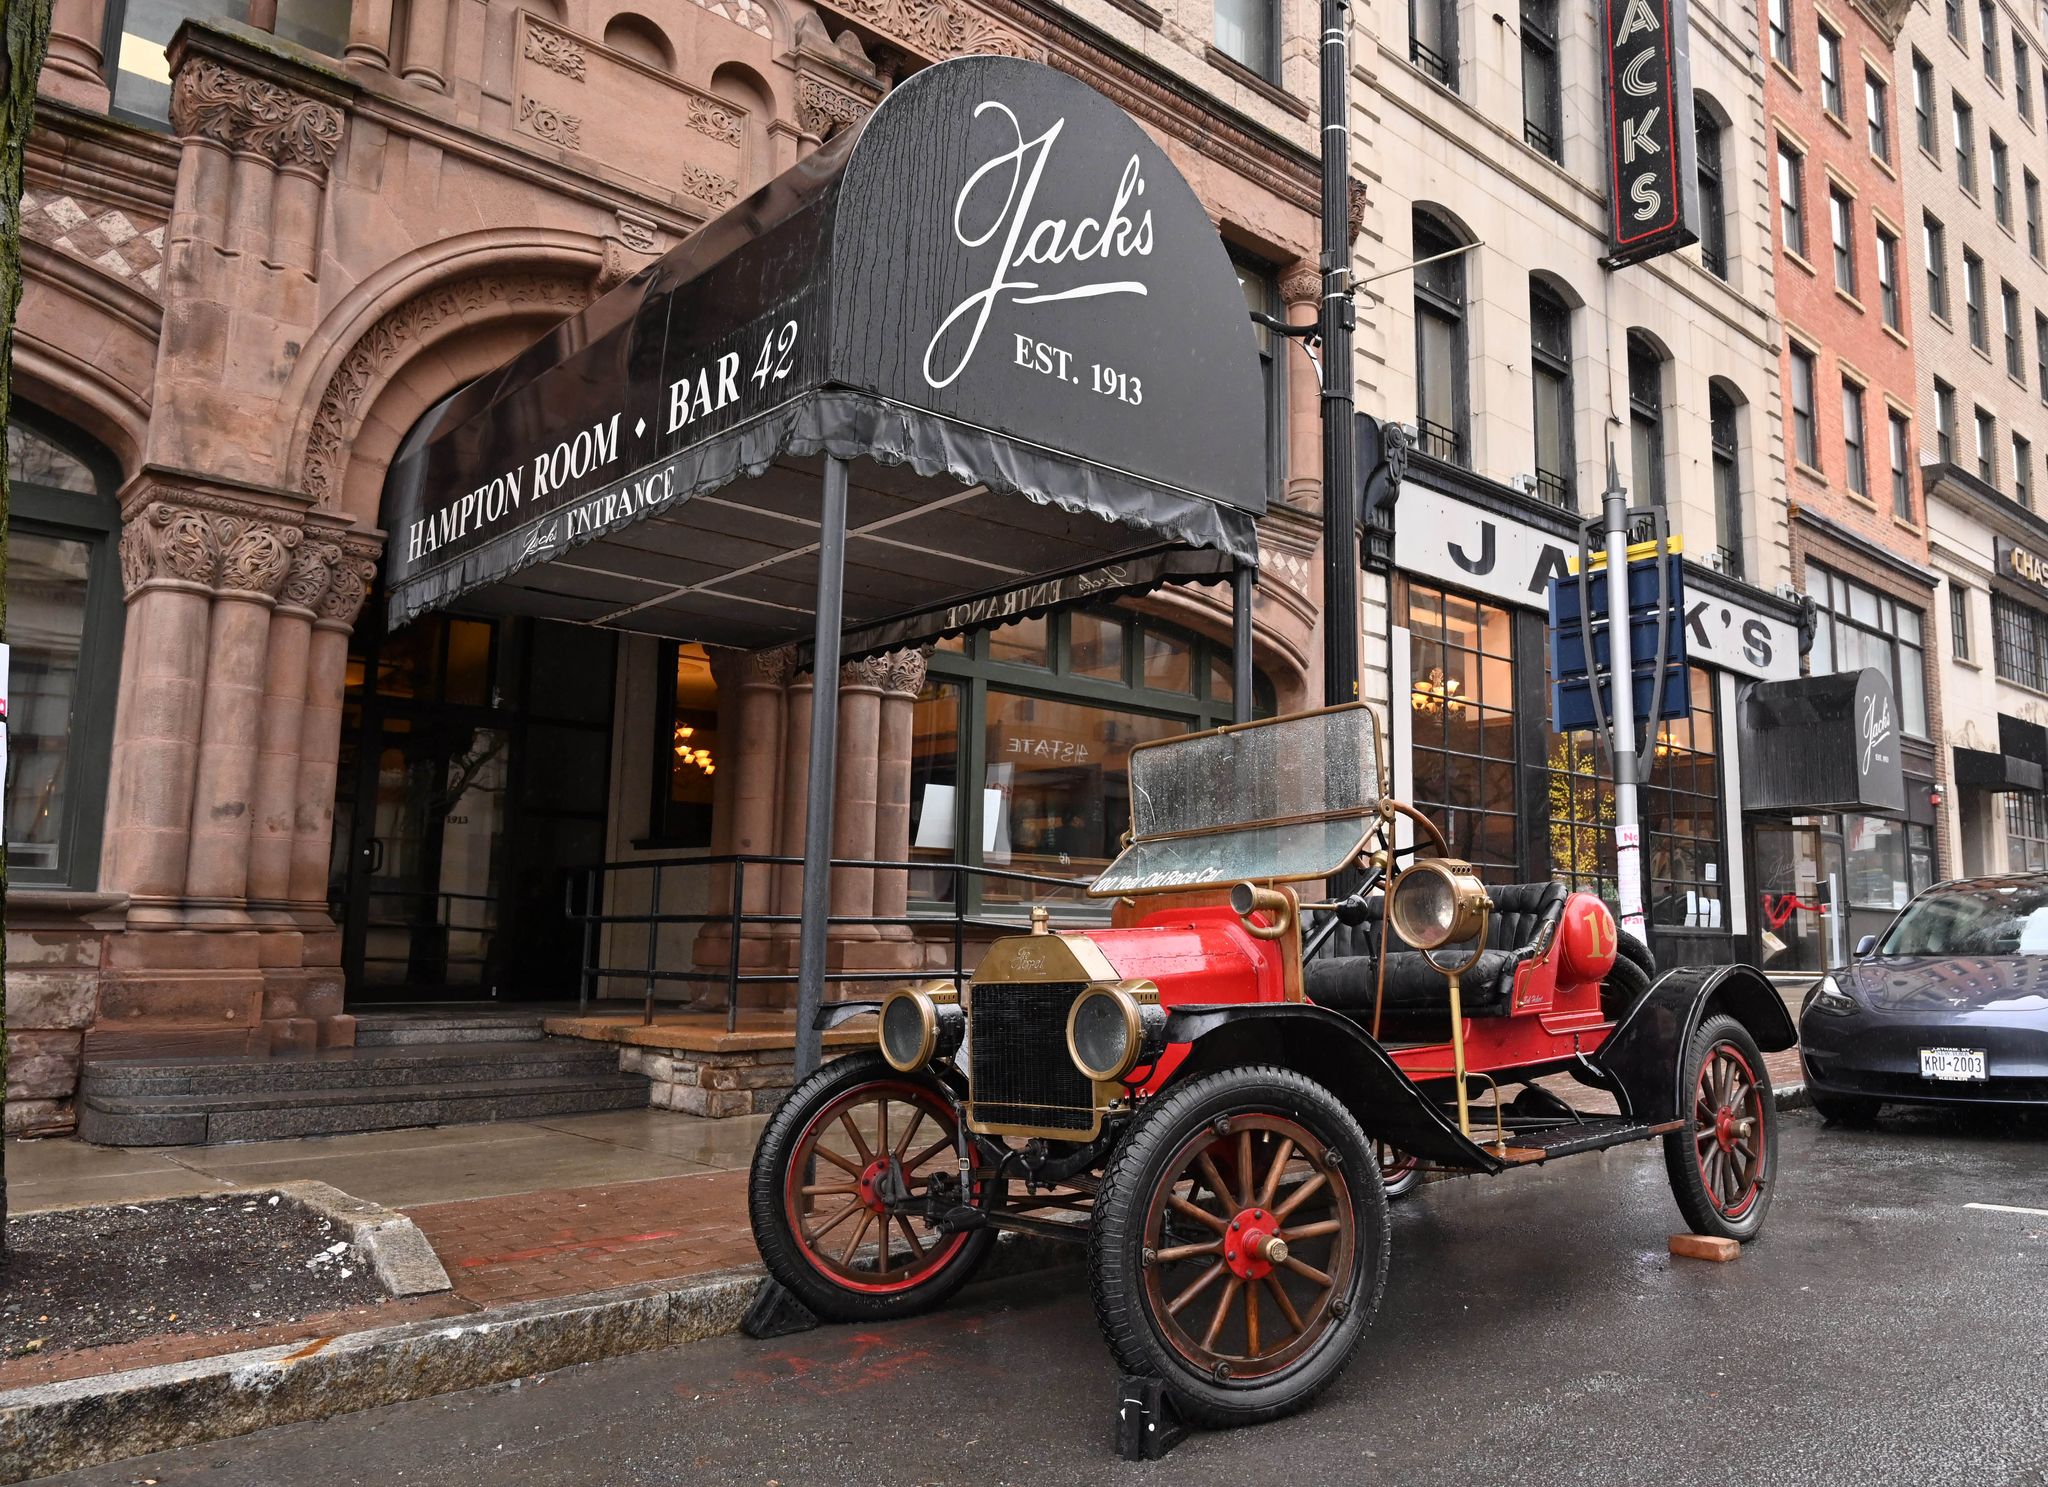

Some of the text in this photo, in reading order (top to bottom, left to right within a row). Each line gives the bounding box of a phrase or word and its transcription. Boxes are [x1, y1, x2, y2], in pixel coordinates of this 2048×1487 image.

[1616, 0, 1661, 221] ACKS
[923, 101, 1154, 389] Jack's
[1013, 333, 1143, 406] EST. 1913
[407, 319, 798, 563] HAMPTON ROOM BAR 42
[566, 467, 675, 541] ENTRANCE
[1448, 520, 1773, 668] JAK'S
[1114, 875, 1144, 890] Year
[1141, 872, 1168, 888] Old
[1165, 869, 1198, 886] Race
[1195, 866, 1224, 883] Car
[1623, 832, 1639, 842] No
